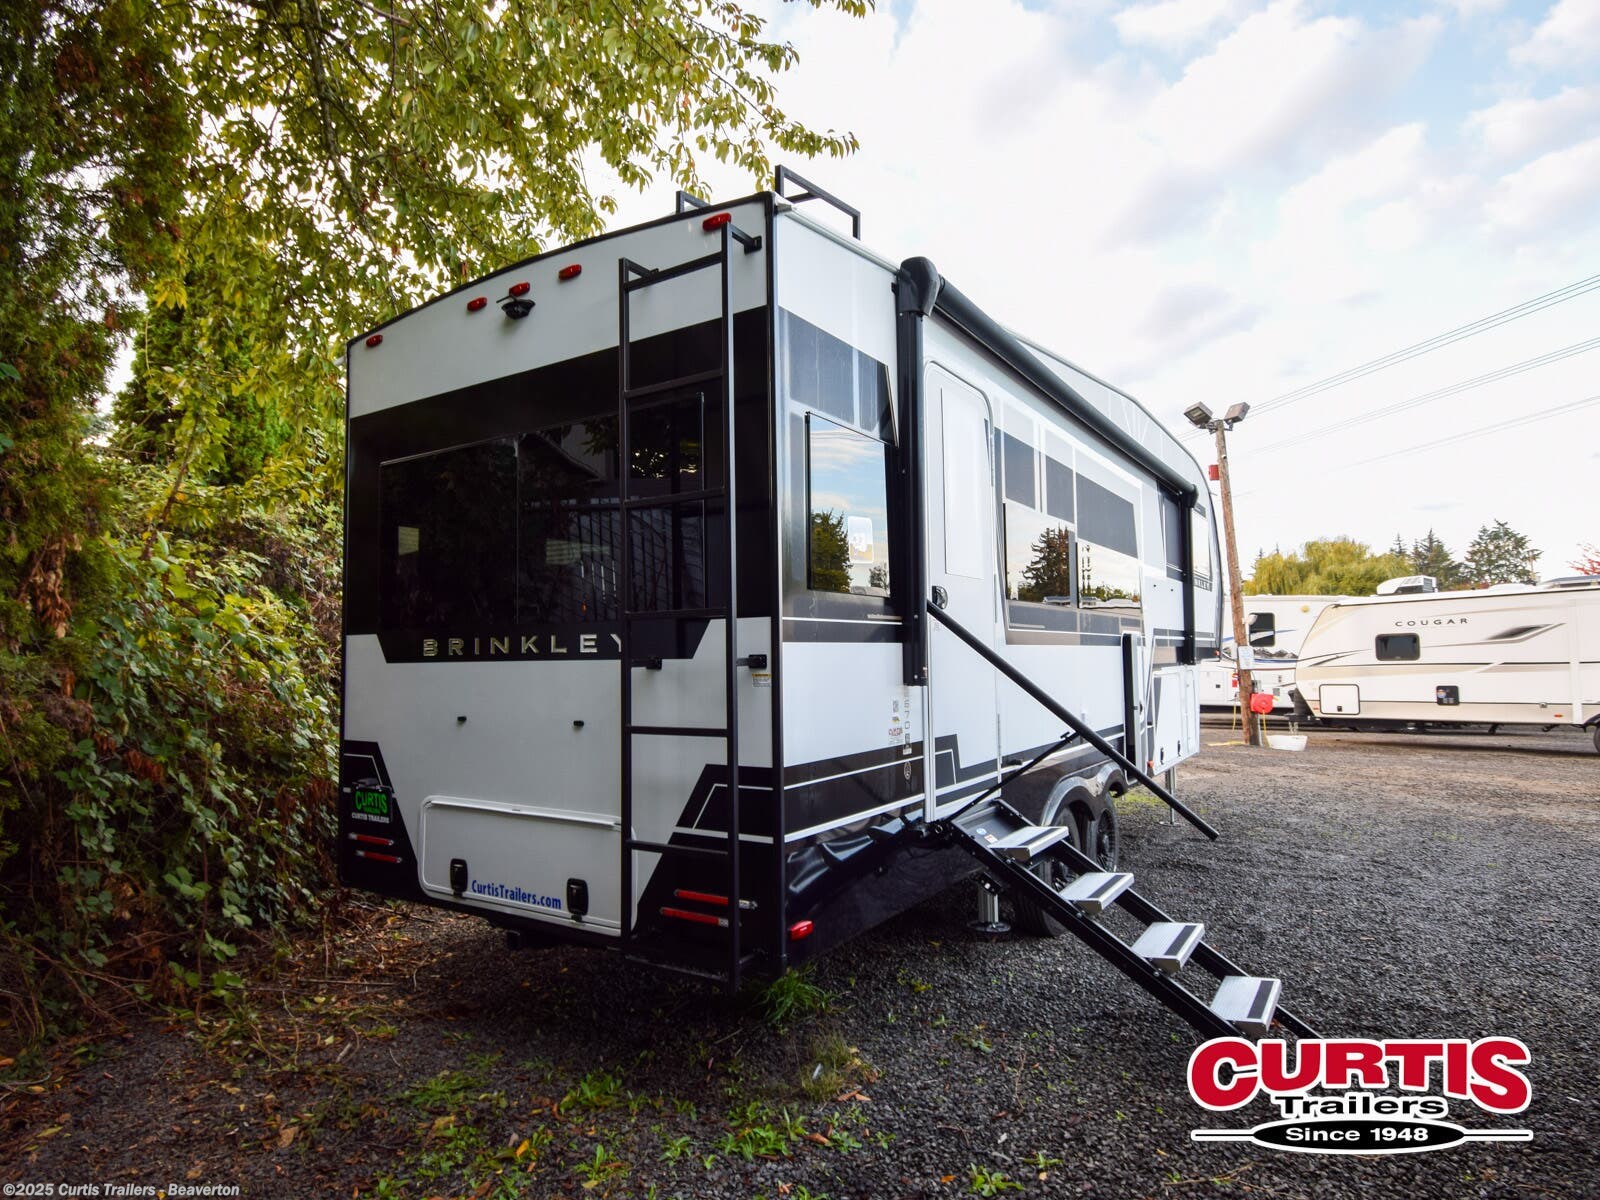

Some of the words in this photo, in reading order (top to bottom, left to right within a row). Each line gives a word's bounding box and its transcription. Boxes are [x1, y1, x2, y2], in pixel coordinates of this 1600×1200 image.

[1394, 617, 1468, 627] COUGAR
[422, 633, 622, 657] BRINKLEY
[355, 790, 388, 815] CURTIS
[471, 879, 562, 910] CurtisTrailers.com
